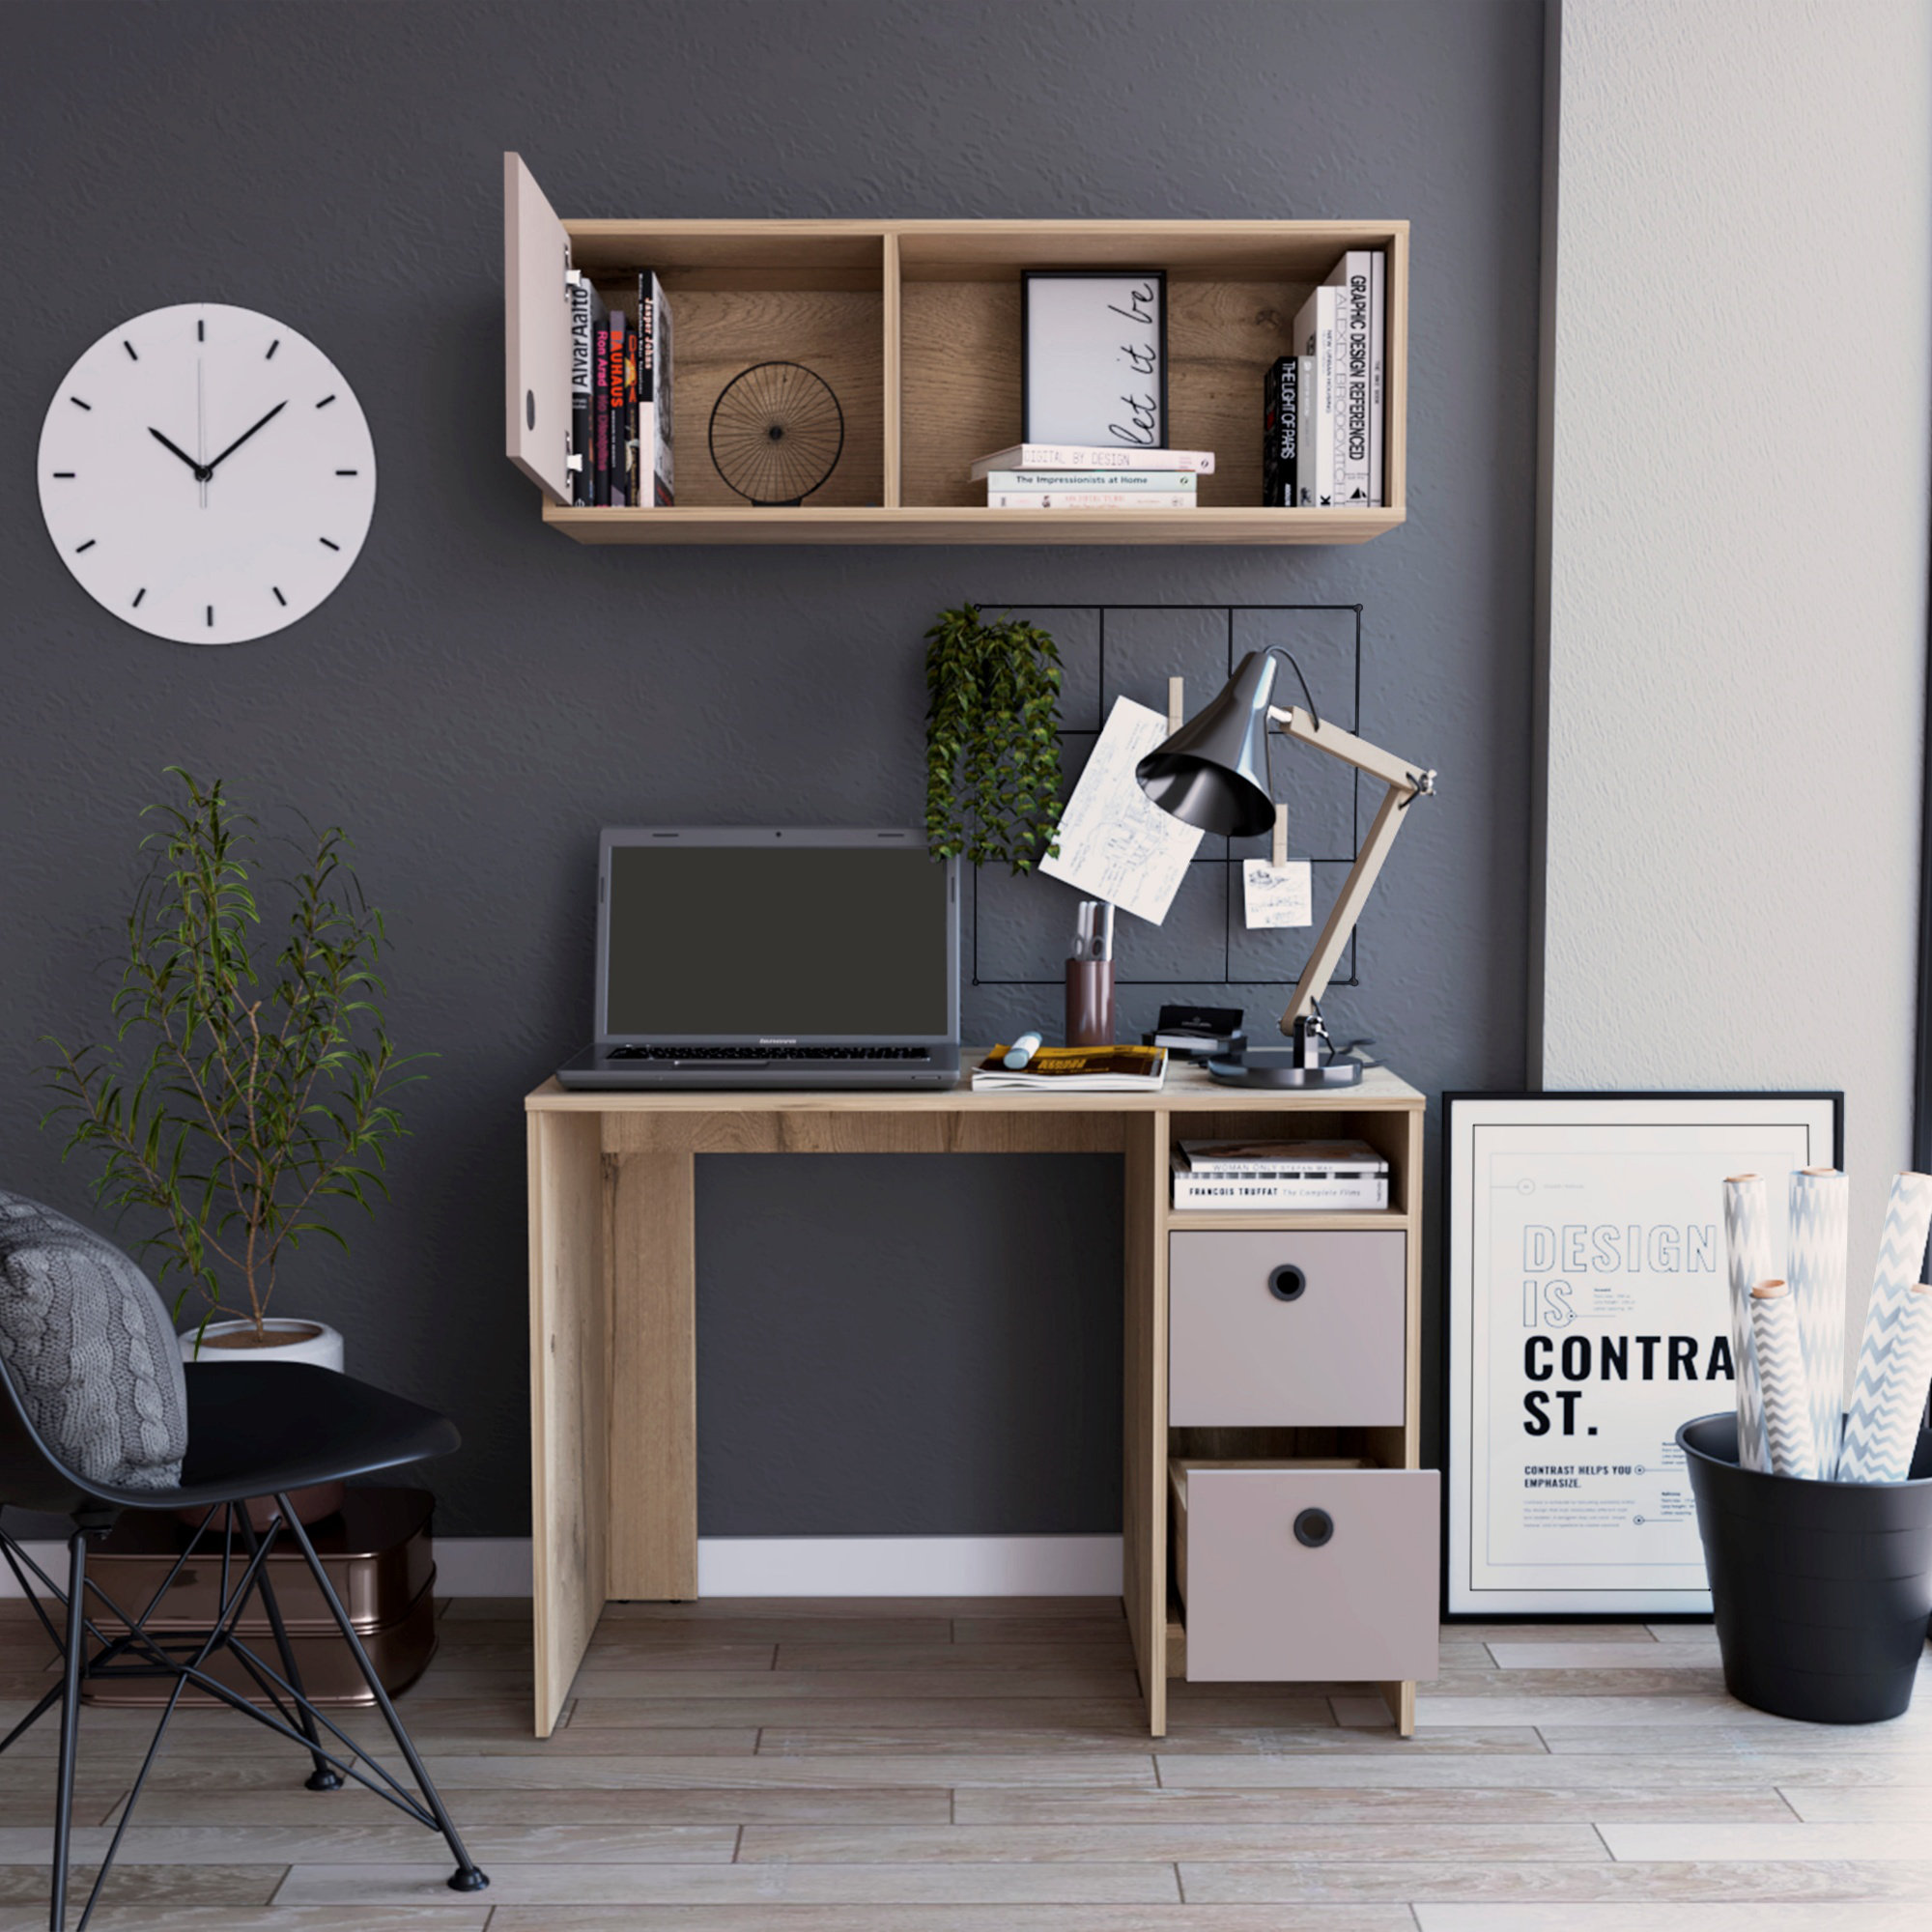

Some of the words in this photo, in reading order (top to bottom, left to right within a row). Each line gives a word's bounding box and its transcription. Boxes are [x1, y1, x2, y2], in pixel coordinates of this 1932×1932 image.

[572, 289, 588, 338] Aalto
[642, 297, 654, 334] Jasper
[1107, 282, 1154, 325] be
[1350, 274, 1366, 329] GRAPHIC
[597, 330, 609, 355] Ron
[1335, 293, 1348, 365] ALEXEY
[572, 340, 588, 387] Alvar
[611, 330, 623, 408] BAUHAUS
[644, 336, 654, 369] Johns
[1116, 344, 1157, 375] it
[1350, 332, 1366, 378] DESIGN
[597, 357, 609, 386] Arad
[1282, 361, 1295, 383] THE
[1281, 383, 1295, 412] LIGHT
[1108, 394, 1157, 444] let
[1281, 413, 1294, 428] OF
[1349, 382, 1365, 461] REFERENCED
[1024, 449, 1065, 465] DIGITAL
[1072, 451, 1084, 465] BY
[1092, 452, 1130, 467] DESIGN
[1280, 429, 1294, 459] PARIS
[1016, 475, 1033, 484] The
[1037, 475, 1105, 486] Impressionists
[1212, 1163, 1249, 1172] WOMAN
[1253, 1163, 1277, 1172] ONLY
[1189, 1187, 1235, 1197] FRANCOIS
[1523, 1225, 1717, 1273] DESIGN
[1522, 1280, 1574, 1328] IS
[1523, 1335, 1735, 1381] CONTRA
[1523, 1390, 1598, 1436] ST.
[1523, 1465, 1575, 1475] CONTRAST
[1577, 1465, 1609, 1475] HELPS
[1611, 1465, 1633, 1475] YOU
[1523, 1479, 1582, 1489] EMPHASIZE.
